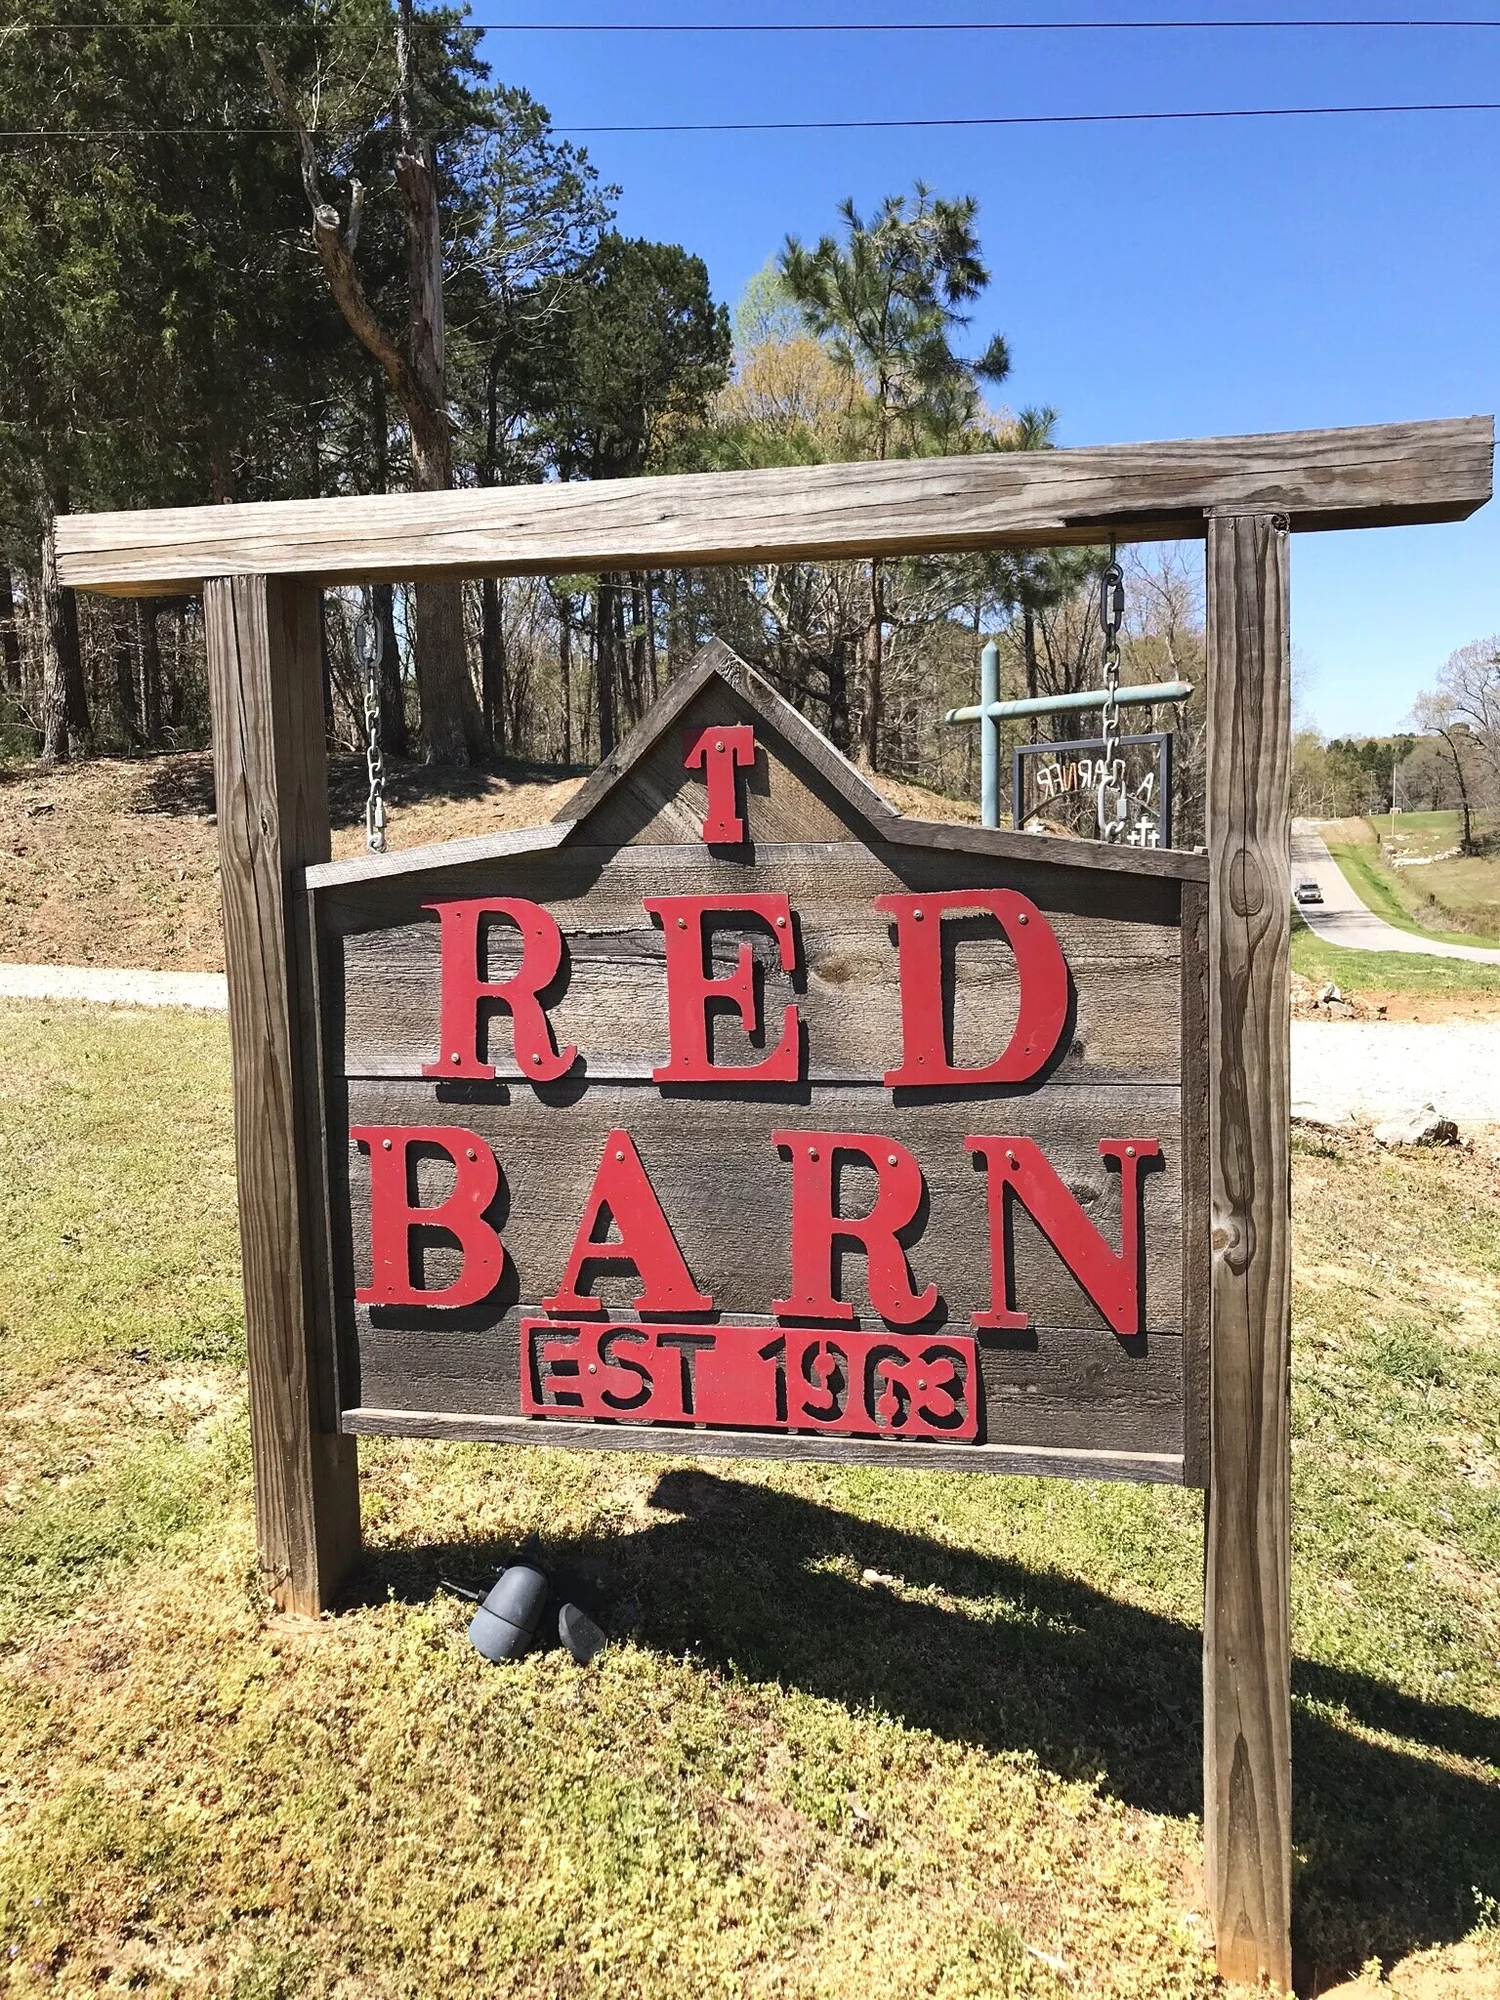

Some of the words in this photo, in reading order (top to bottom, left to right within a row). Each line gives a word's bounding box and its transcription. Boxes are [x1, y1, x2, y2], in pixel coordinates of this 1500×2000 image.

[421, 888, 1068, 1087] RED
[349, 1126, 1160, 1335] BARN
[528, 1327, 716, 1416] EST
[757, 1332, 970, 1431] 1963
